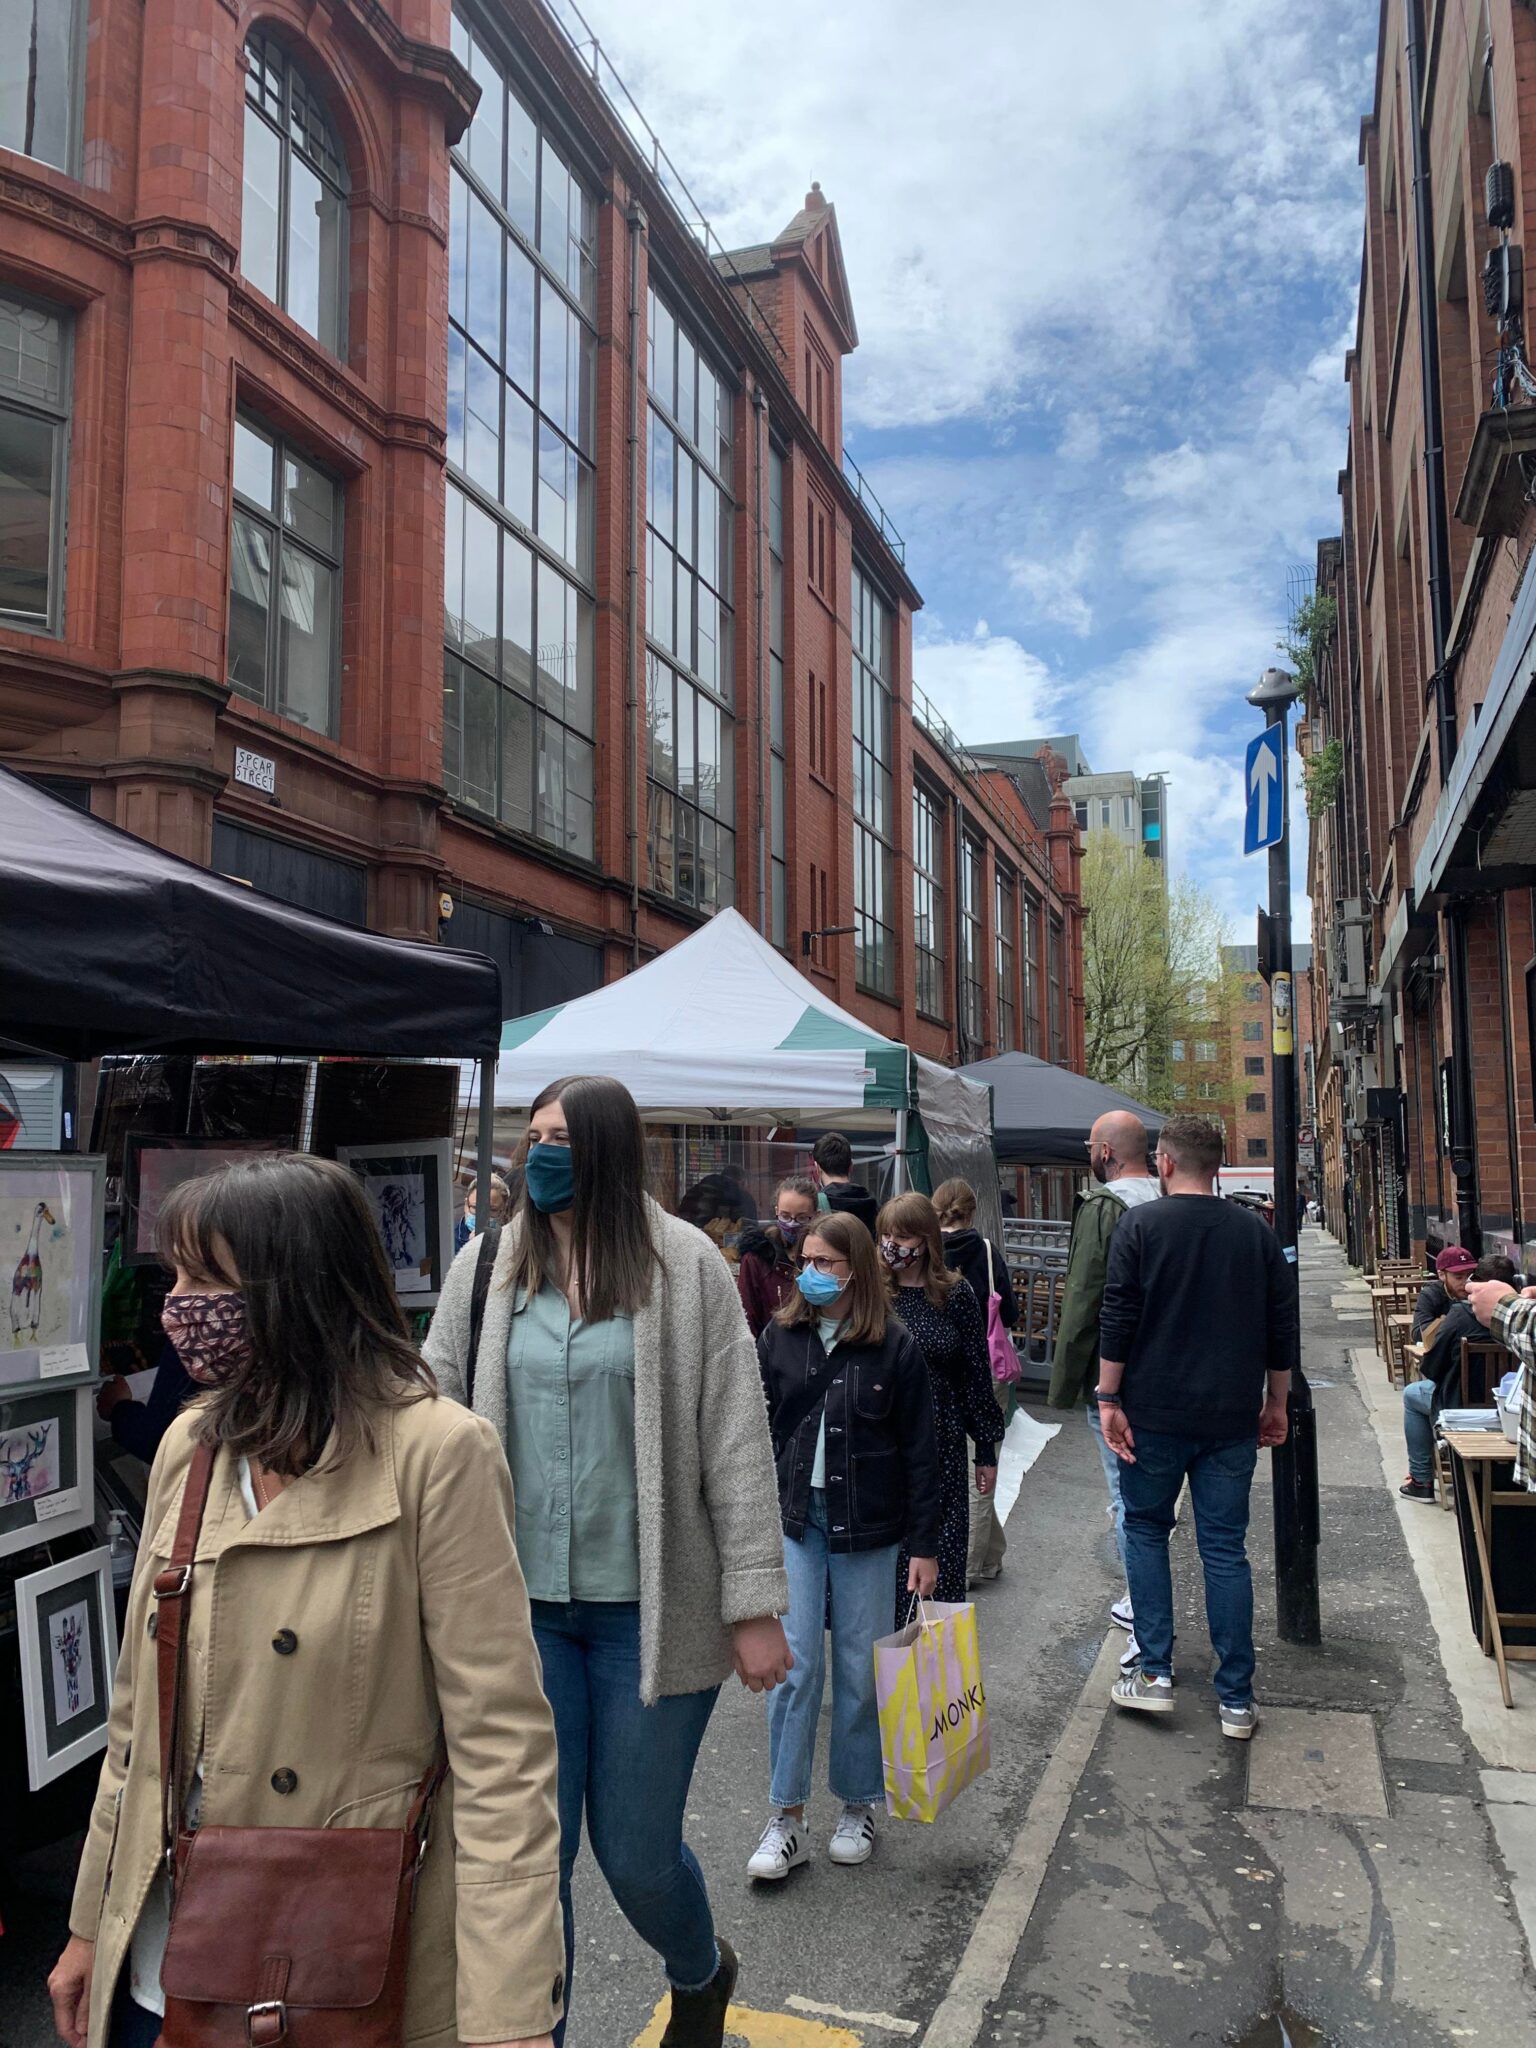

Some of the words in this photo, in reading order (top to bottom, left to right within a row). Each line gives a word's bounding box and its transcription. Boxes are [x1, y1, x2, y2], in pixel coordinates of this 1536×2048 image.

[239, 751, 272, 775] SPEAR
[236, 765, 274, 790] STREET
[930, 1682, 986, 1741] MONKI
